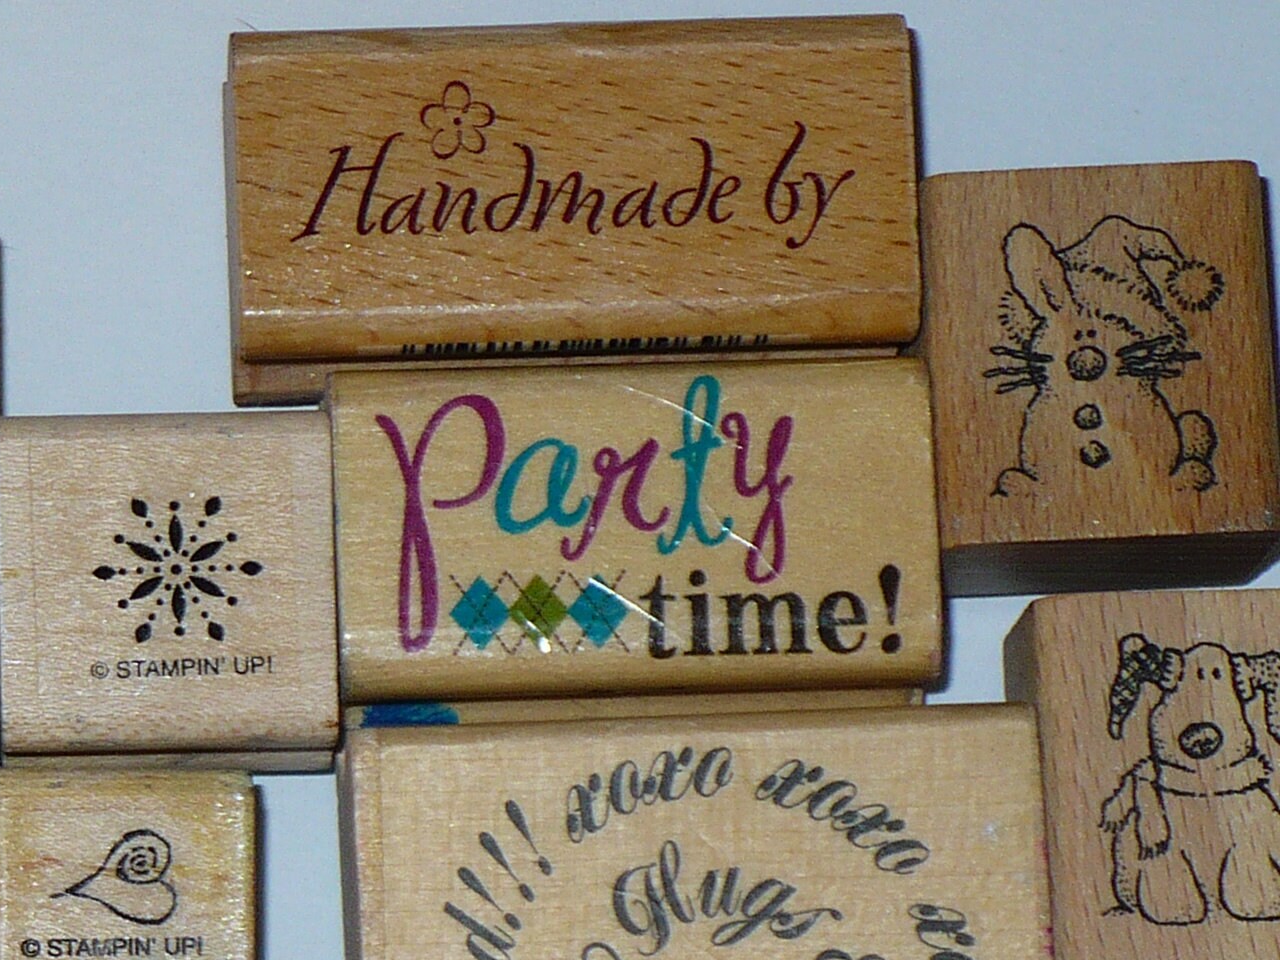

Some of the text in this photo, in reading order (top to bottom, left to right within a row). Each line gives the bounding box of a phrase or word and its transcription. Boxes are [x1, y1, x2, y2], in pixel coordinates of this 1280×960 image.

[290, 121, 856, 249] Handmade by
[643, 563, 903, 660] time!
[116, 656, 225, 679] STAMPIN'
[234, 655, 278, 675] UP!
[565, 746, 734, 844] xoxo
[754, 759, 930, 875] xoxo
[47, 937, 157, 957] STAMPIN'
[165, 936, 205, 957] UP!
[612, 839, 843, 956] Hugs
